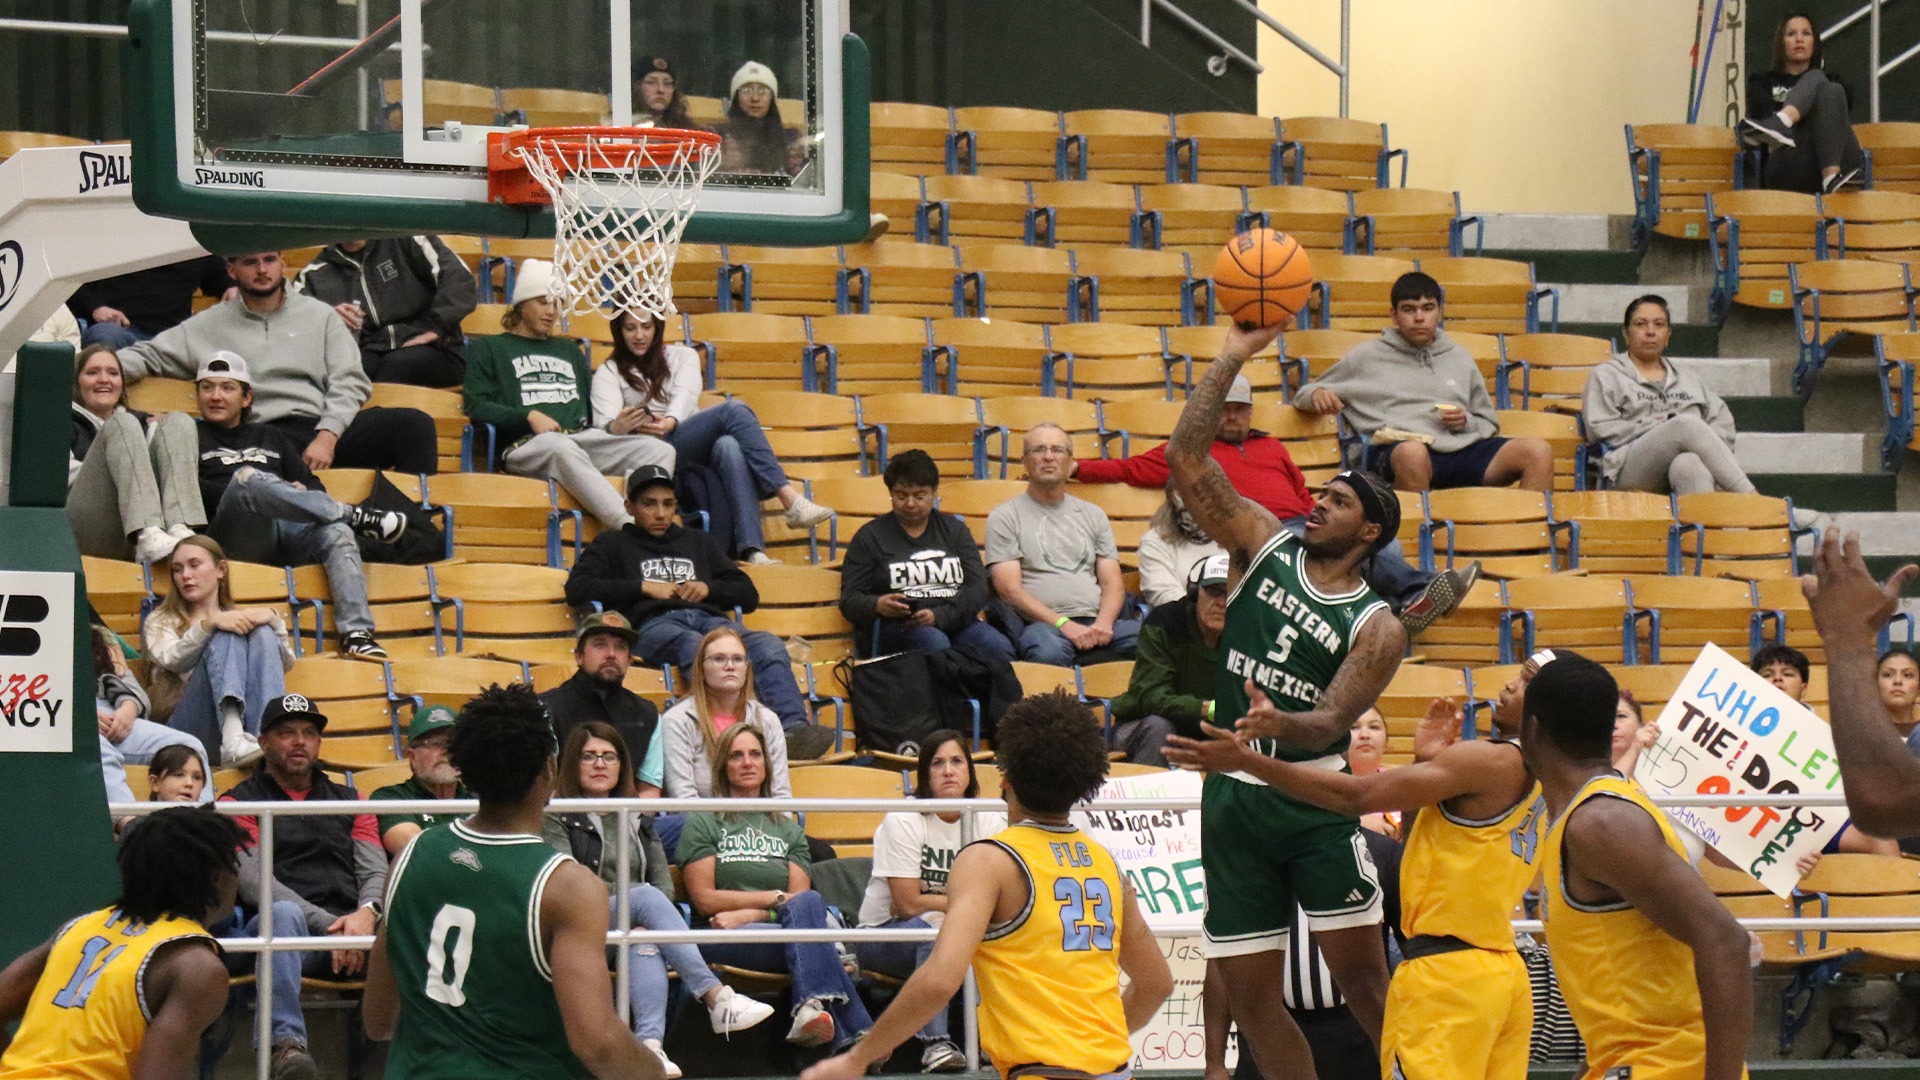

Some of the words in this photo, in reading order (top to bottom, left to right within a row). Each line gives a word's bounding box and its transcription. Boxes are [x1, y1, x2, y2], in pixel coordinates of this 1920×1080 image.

[79, 151, 132, 194] SPAL
[195, 168, 265, 188] SPALDING
[889, 556, 964, 590] ENMU
[1256, 577, 1342, 655] EASTERN
[1226, 648, 1256, 679] NEW
[1266, 624, 1299, 664] 5
[1677, 701, 1738, 758] THE
[1697, 668, 1780, 736] WHO
[1778, 731, 1842, 790] LET
[1641, 735, 1699, 789] #5
[1696, 776, 1781, 838] OUT
[1049, 842, 1093, 867] FLC
[1166, 834, 1199, 855] he's
[1053, 877, 1116, 951] 23
[425, 904, 476, 1007] 0
[1163, 937, 1207, 961] Jas
